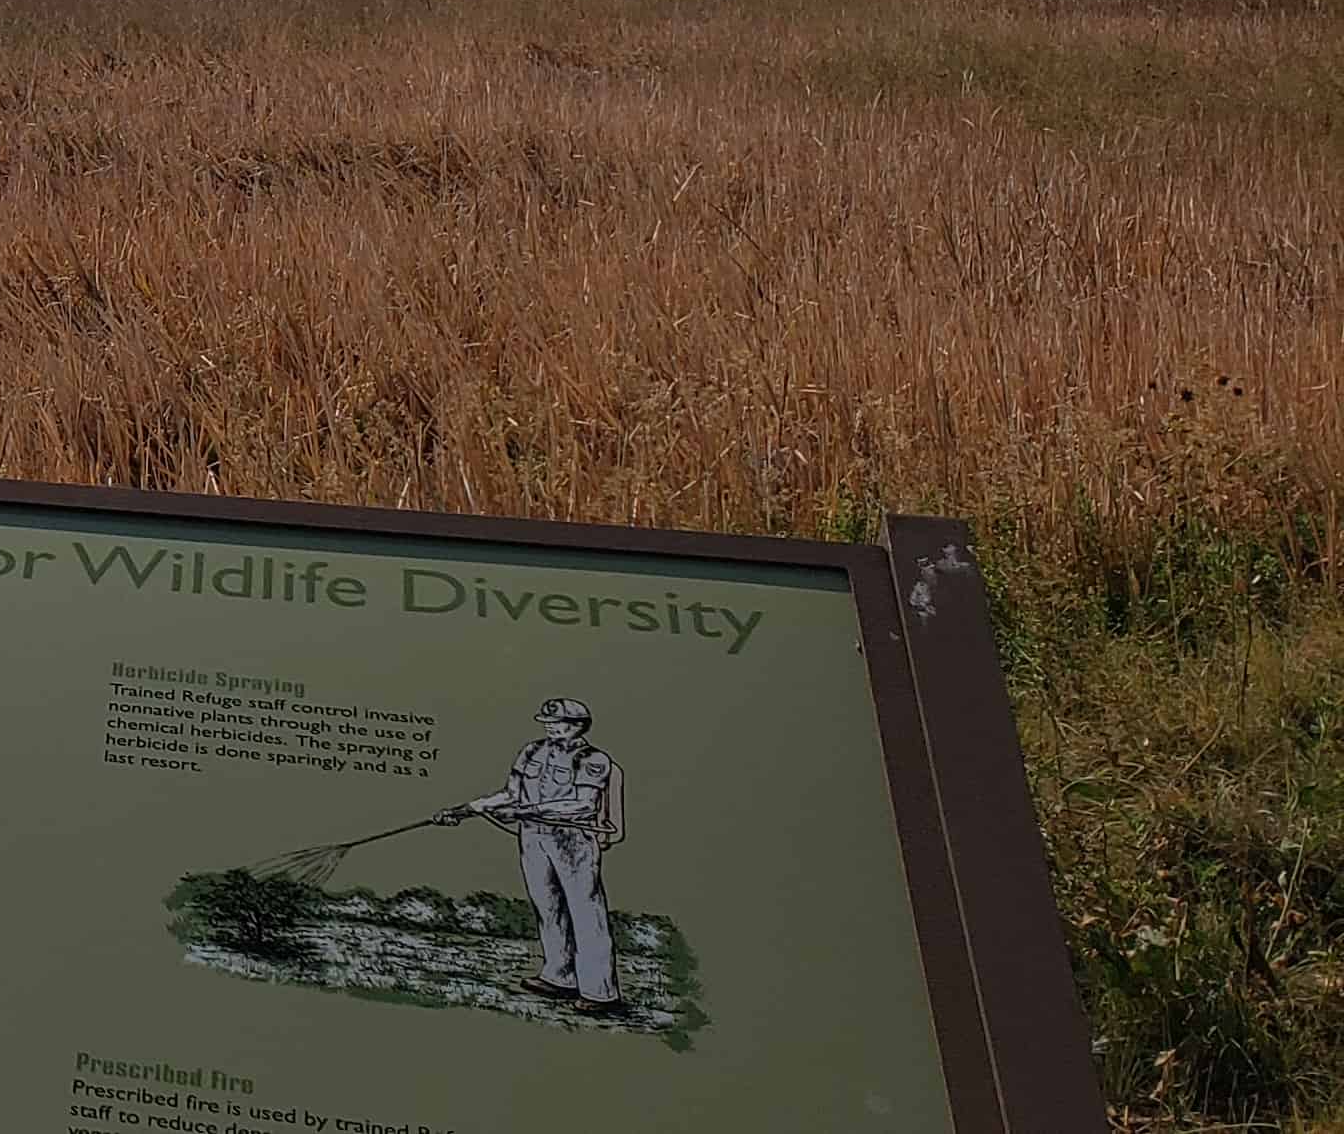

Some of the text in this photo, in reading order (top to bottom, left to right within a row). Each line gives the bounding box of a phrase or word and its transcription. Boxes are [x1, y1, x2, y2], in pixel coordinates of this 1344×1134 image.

[70, 540, 369, 610] Wildlife
[400, 566, 771, 661] Diversity
[112, 662, 305, 699] Herbicide Spraying
[108, 682, 435, 726] Trained Refuge staff control invasive
[108, 702, 433, 743] nonnative plants through the use of
[104, 732, 429, 778] herbicide is done sparingly and as a
[106, 716, 441, 763] chemical herbicides. The spraying of
[103, 749, 203, 773] last resort.
[76, 1052, 203, 1088] Prescribed
[69, 1104, 114, 1122] staff
[118, 1110, 141, 1125] to
[147, 1114, 218, 1134] reduce
[72, 1078, 179, 1109] Prescribed
[186, 1094, 220, 1115] fire
[226, 1100, 242, 1117] is
[248, 1106, 297, 1125] used
[304, 1109, 329, 1133] by
